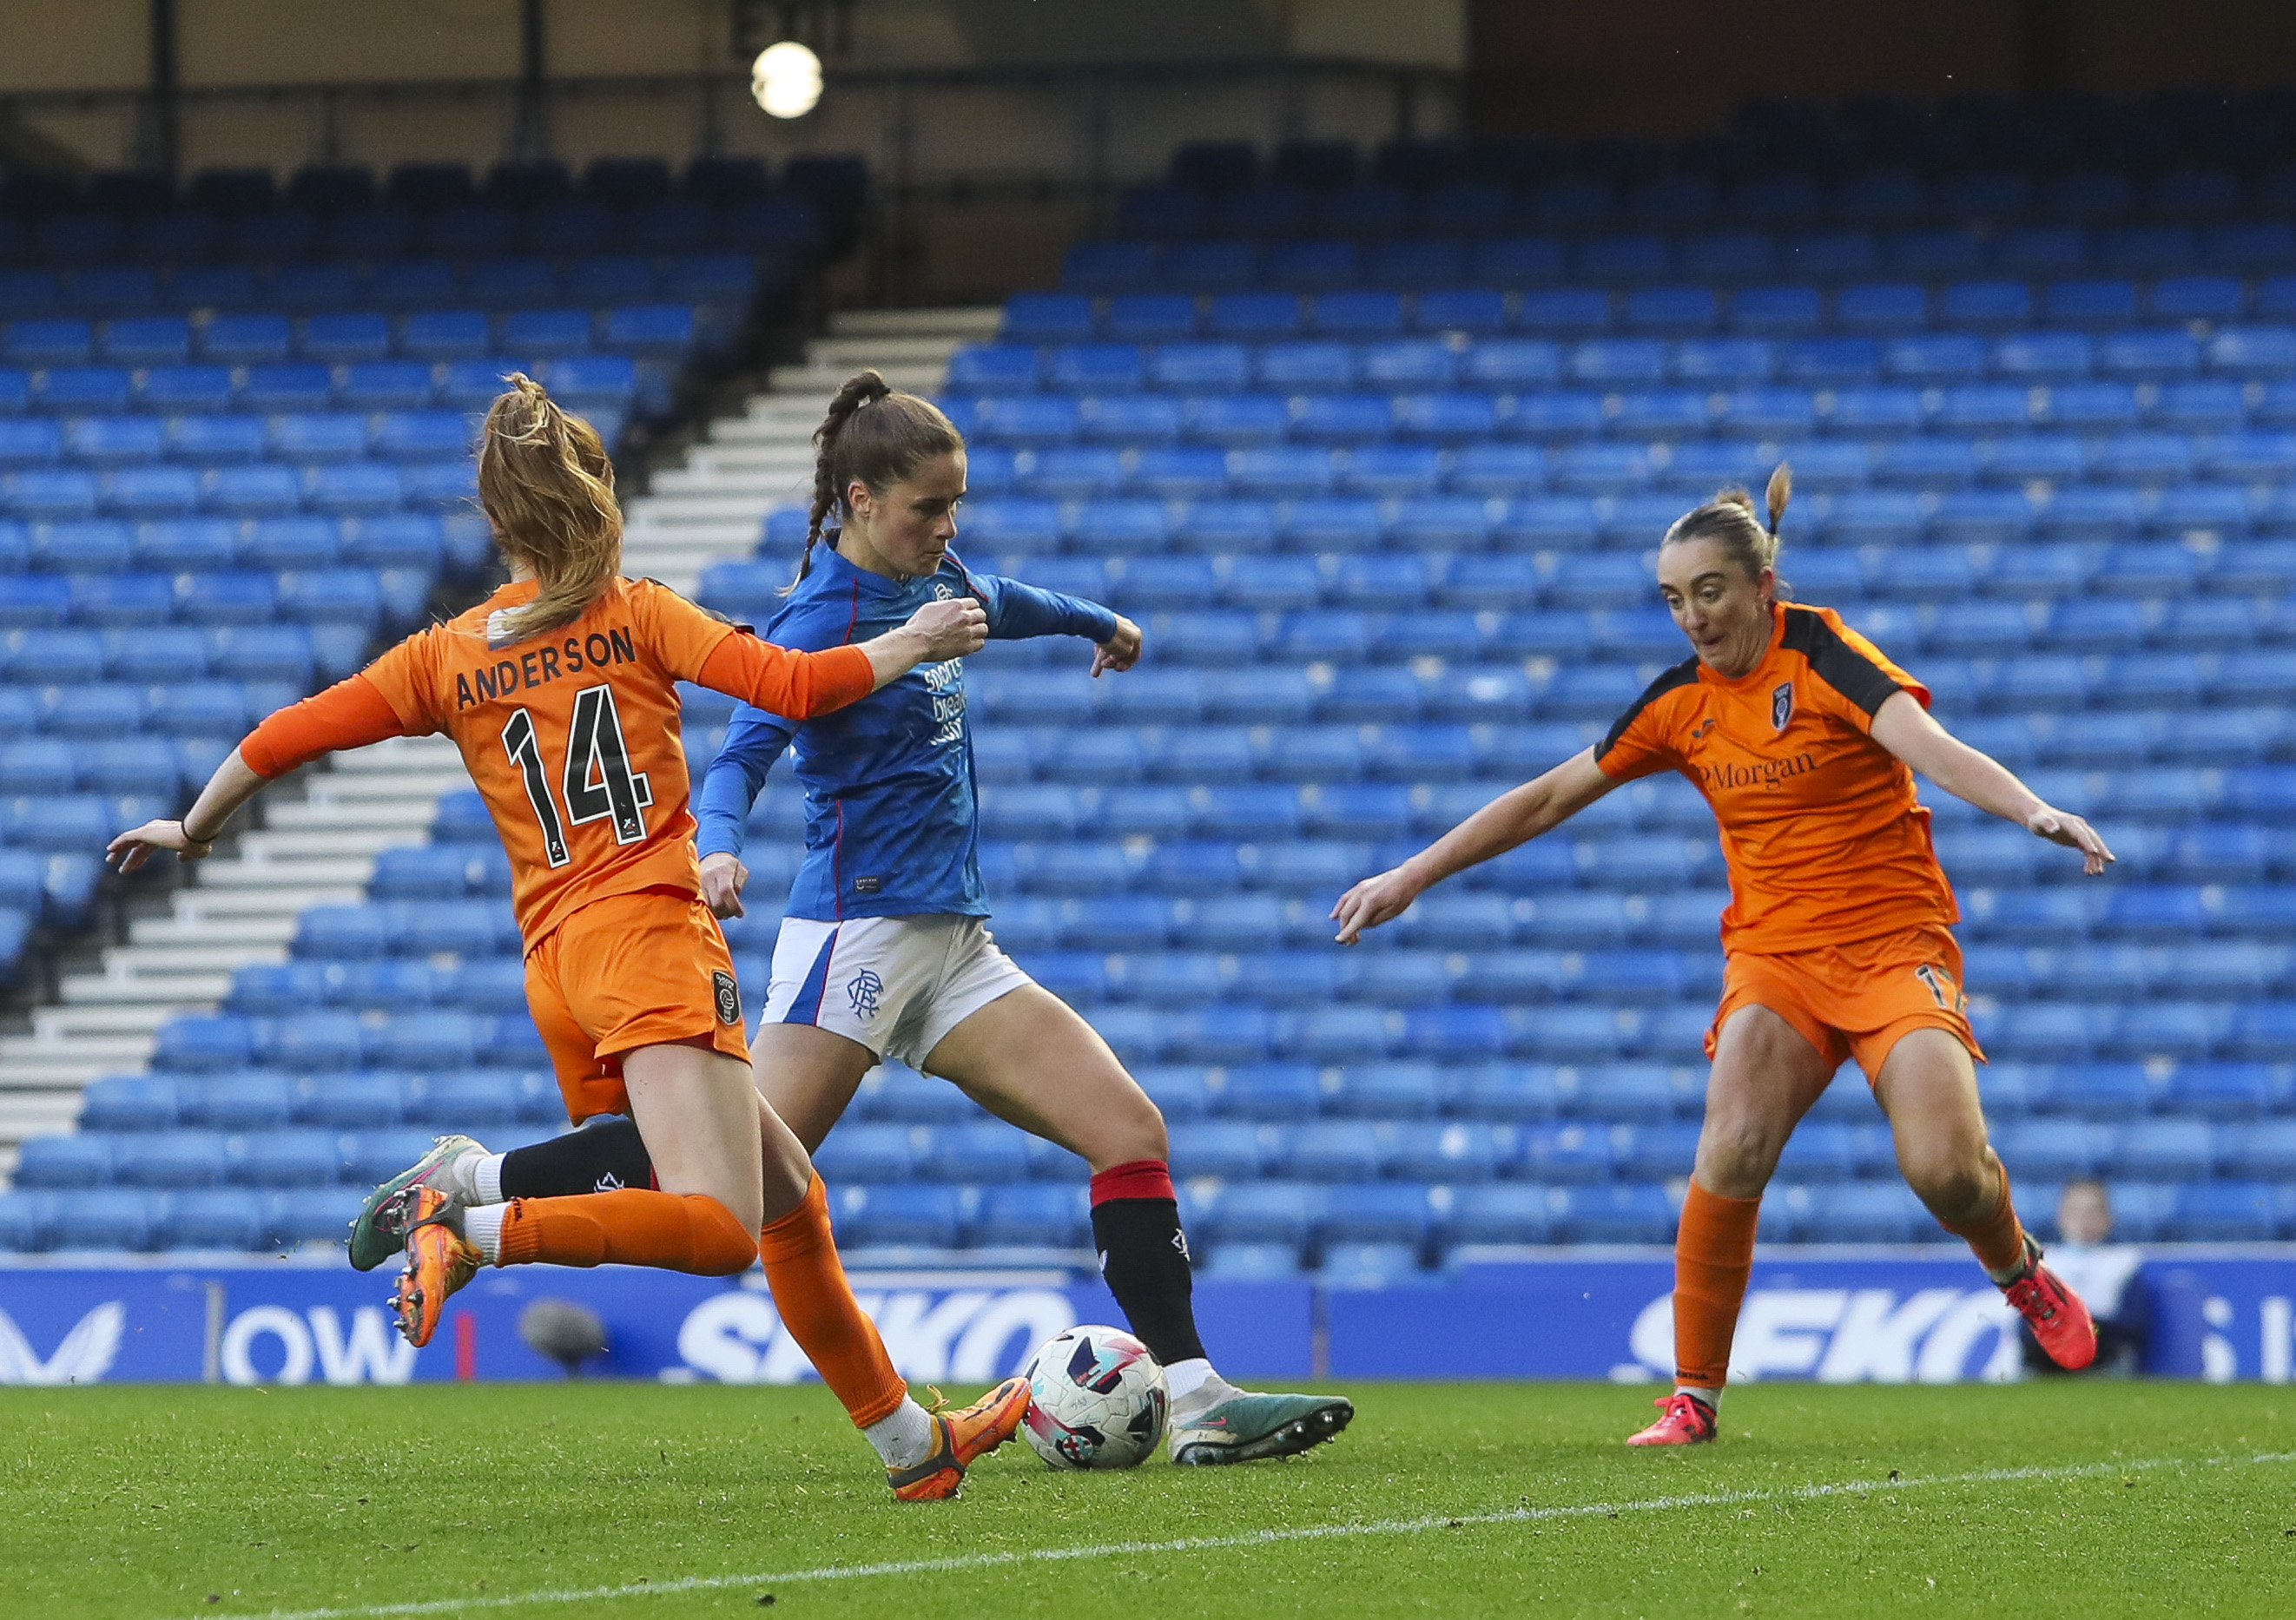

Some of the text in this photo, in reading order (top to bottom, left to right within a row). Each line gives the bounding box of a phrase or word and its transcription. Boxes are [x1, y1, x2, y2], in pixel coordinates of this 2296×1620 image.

[456, 626, 636, 711] ANDERSON
[500, 683, 654, 869] 14
[676, 1290, 1079, 1385] SKO
